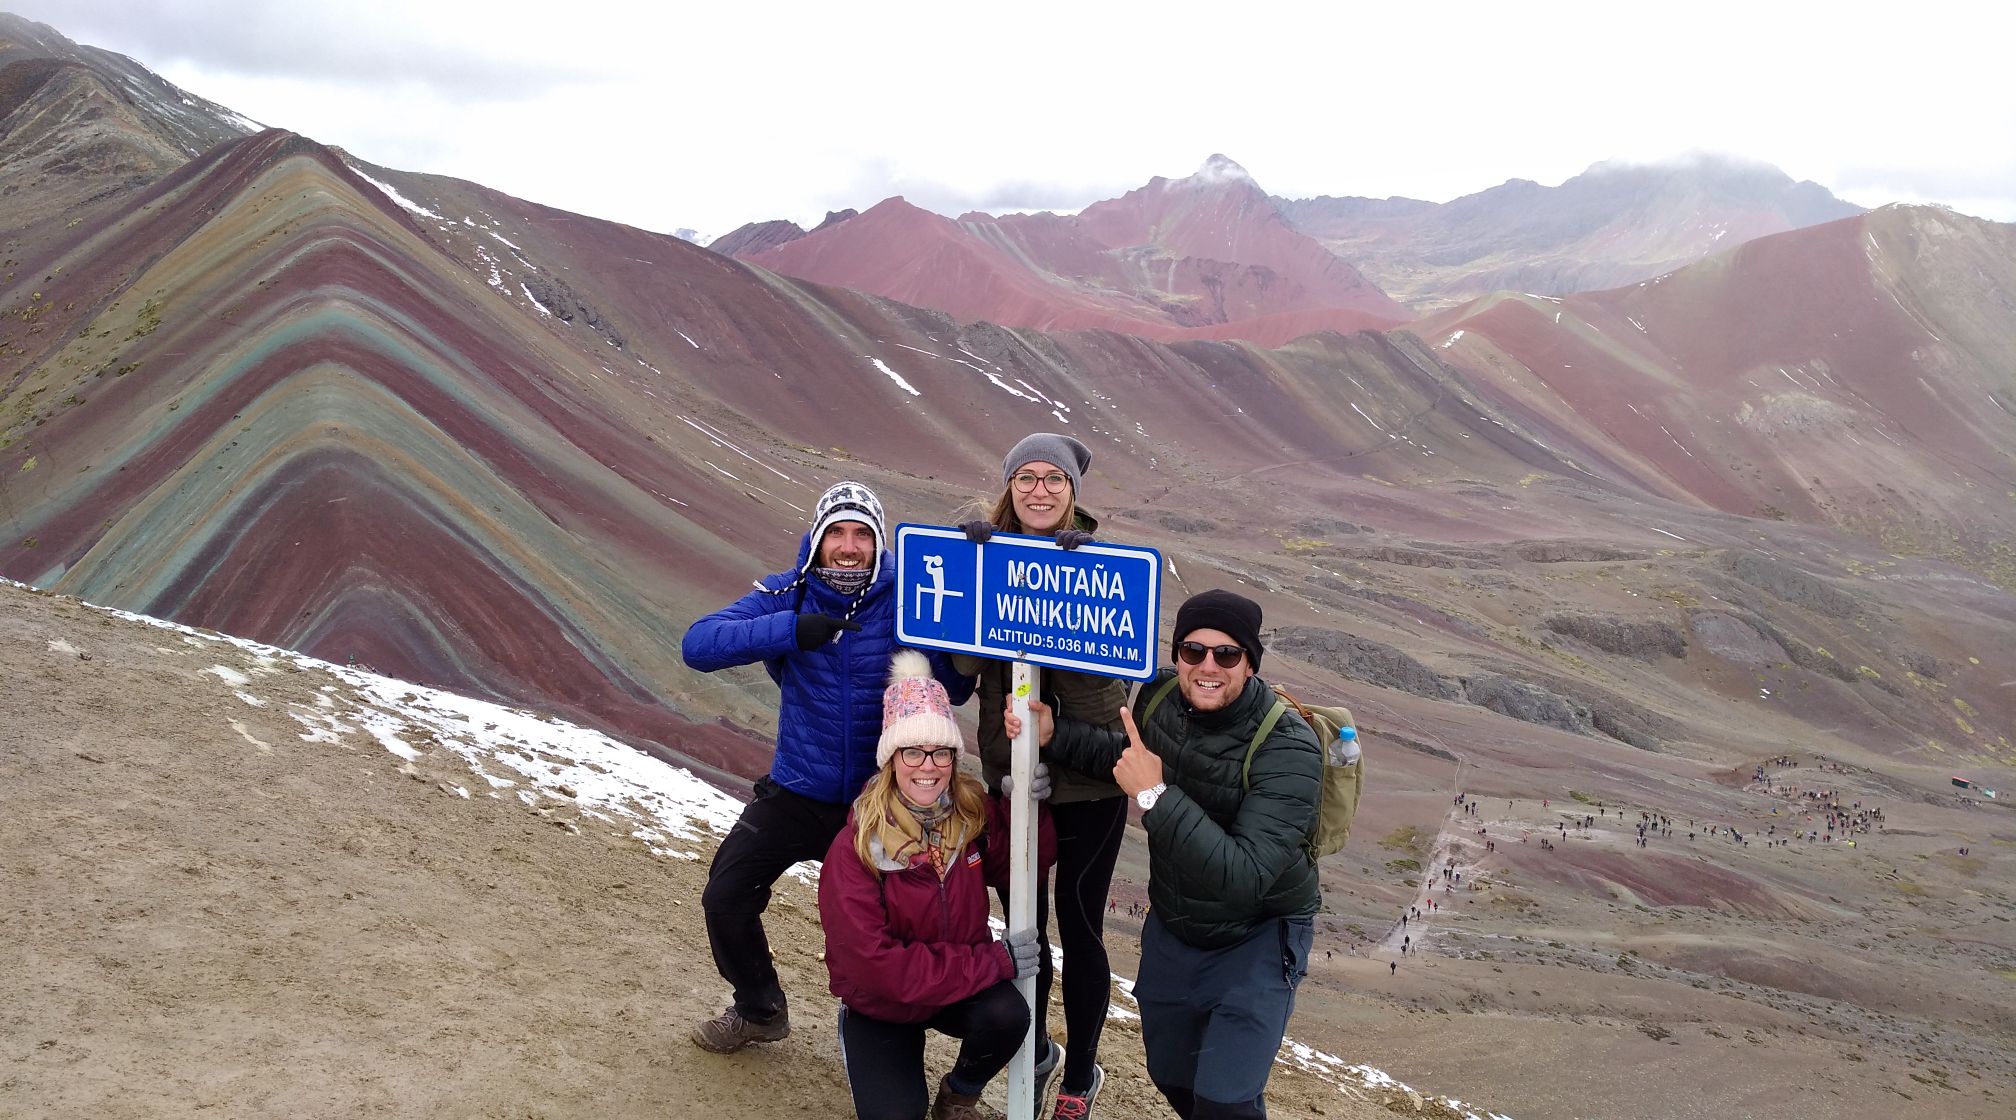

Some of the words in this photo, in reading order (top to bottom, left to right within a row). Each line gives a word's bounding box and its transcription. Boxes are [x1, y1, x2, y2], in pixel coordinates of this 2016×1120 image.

[1007, 559, 1125, 601] MONTAÑA
[996, 592, 1135, 639] WINIKUNKA
[1084, 641, 1142, 662] M.S.N.M.
